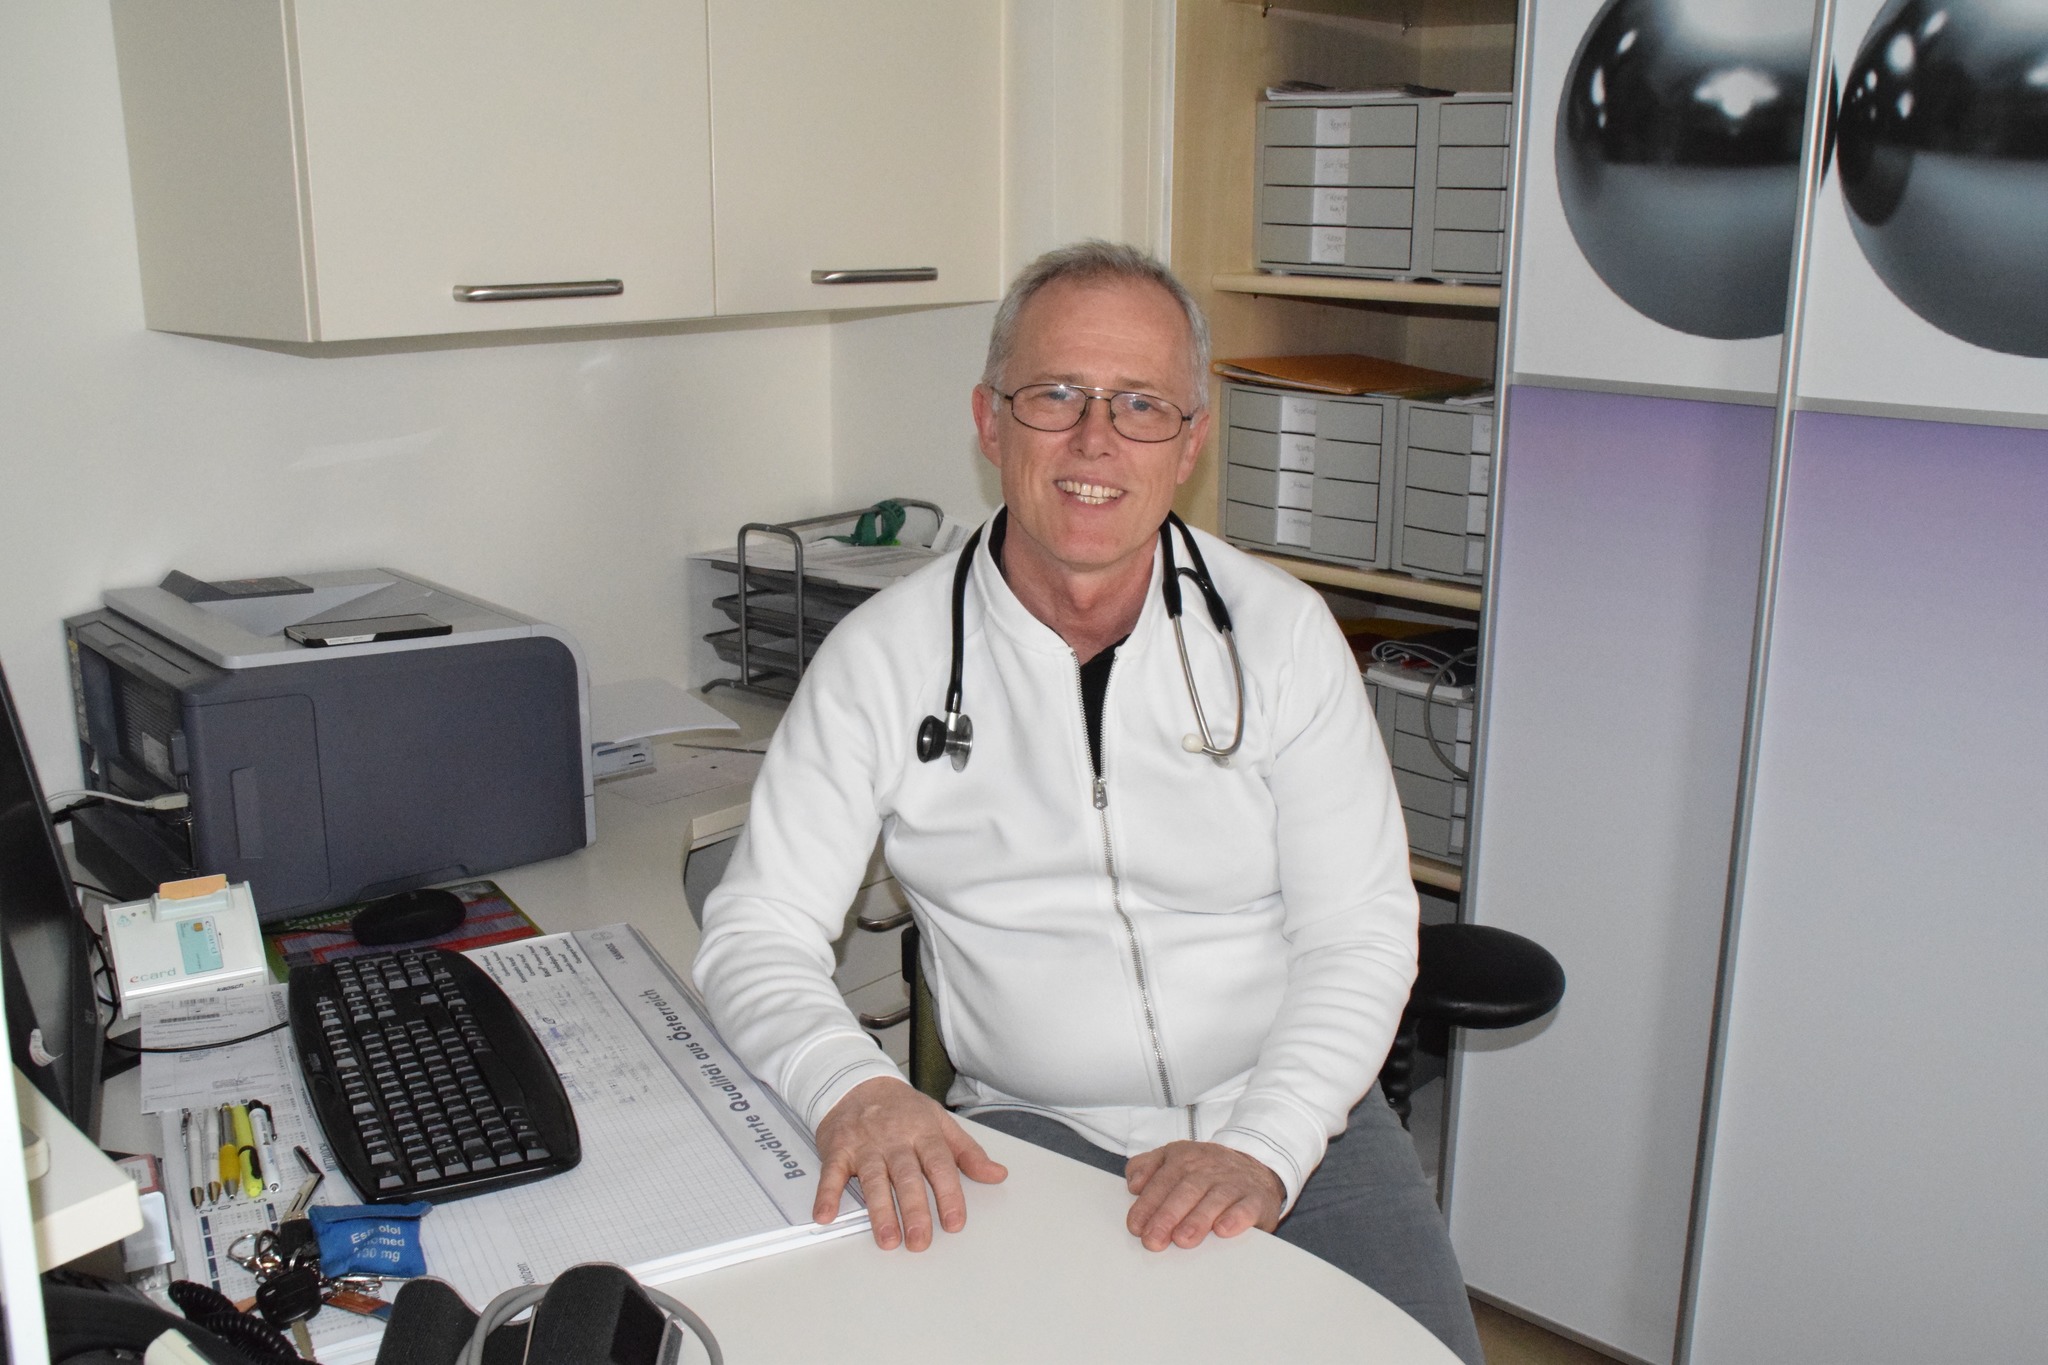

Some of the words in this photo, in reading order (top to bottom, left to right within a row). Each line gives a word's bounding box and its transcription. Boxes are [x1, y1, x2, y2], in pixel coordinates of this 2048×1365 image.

[130, 967, 176, 984] ecard
[638, 988, 692, 1041] Österreich
[686, 1042, 710, 1061] aus
[700, 1063, 751, 1112] Qualität
[745, 1114, 807, 1180] Bewährte
[381, 1249, 400, 1262] mg
